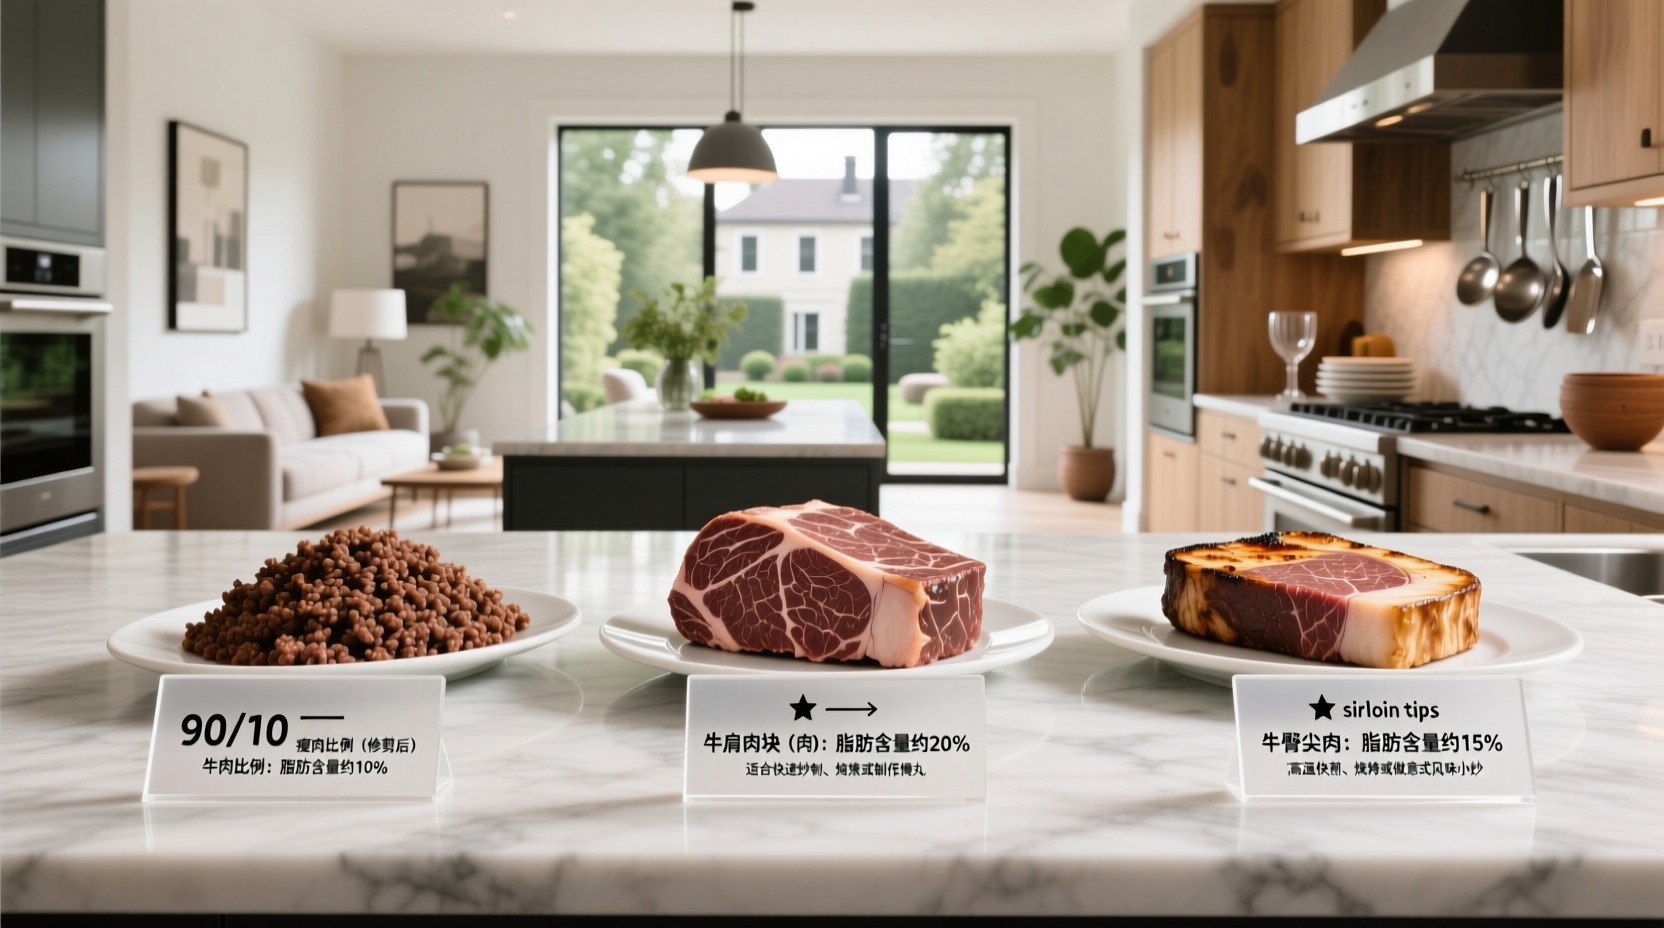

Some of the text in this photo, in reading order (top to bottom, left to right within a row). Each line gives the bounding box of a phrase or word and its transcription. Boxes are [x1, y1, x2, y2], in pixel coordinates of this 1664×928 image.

[1342, 699, 1440, 723] sirloin tips
[180, 711, 289, 748] 90/10
[202, 757, 389, 776] 牛肉比例：脂肪含量约10%
